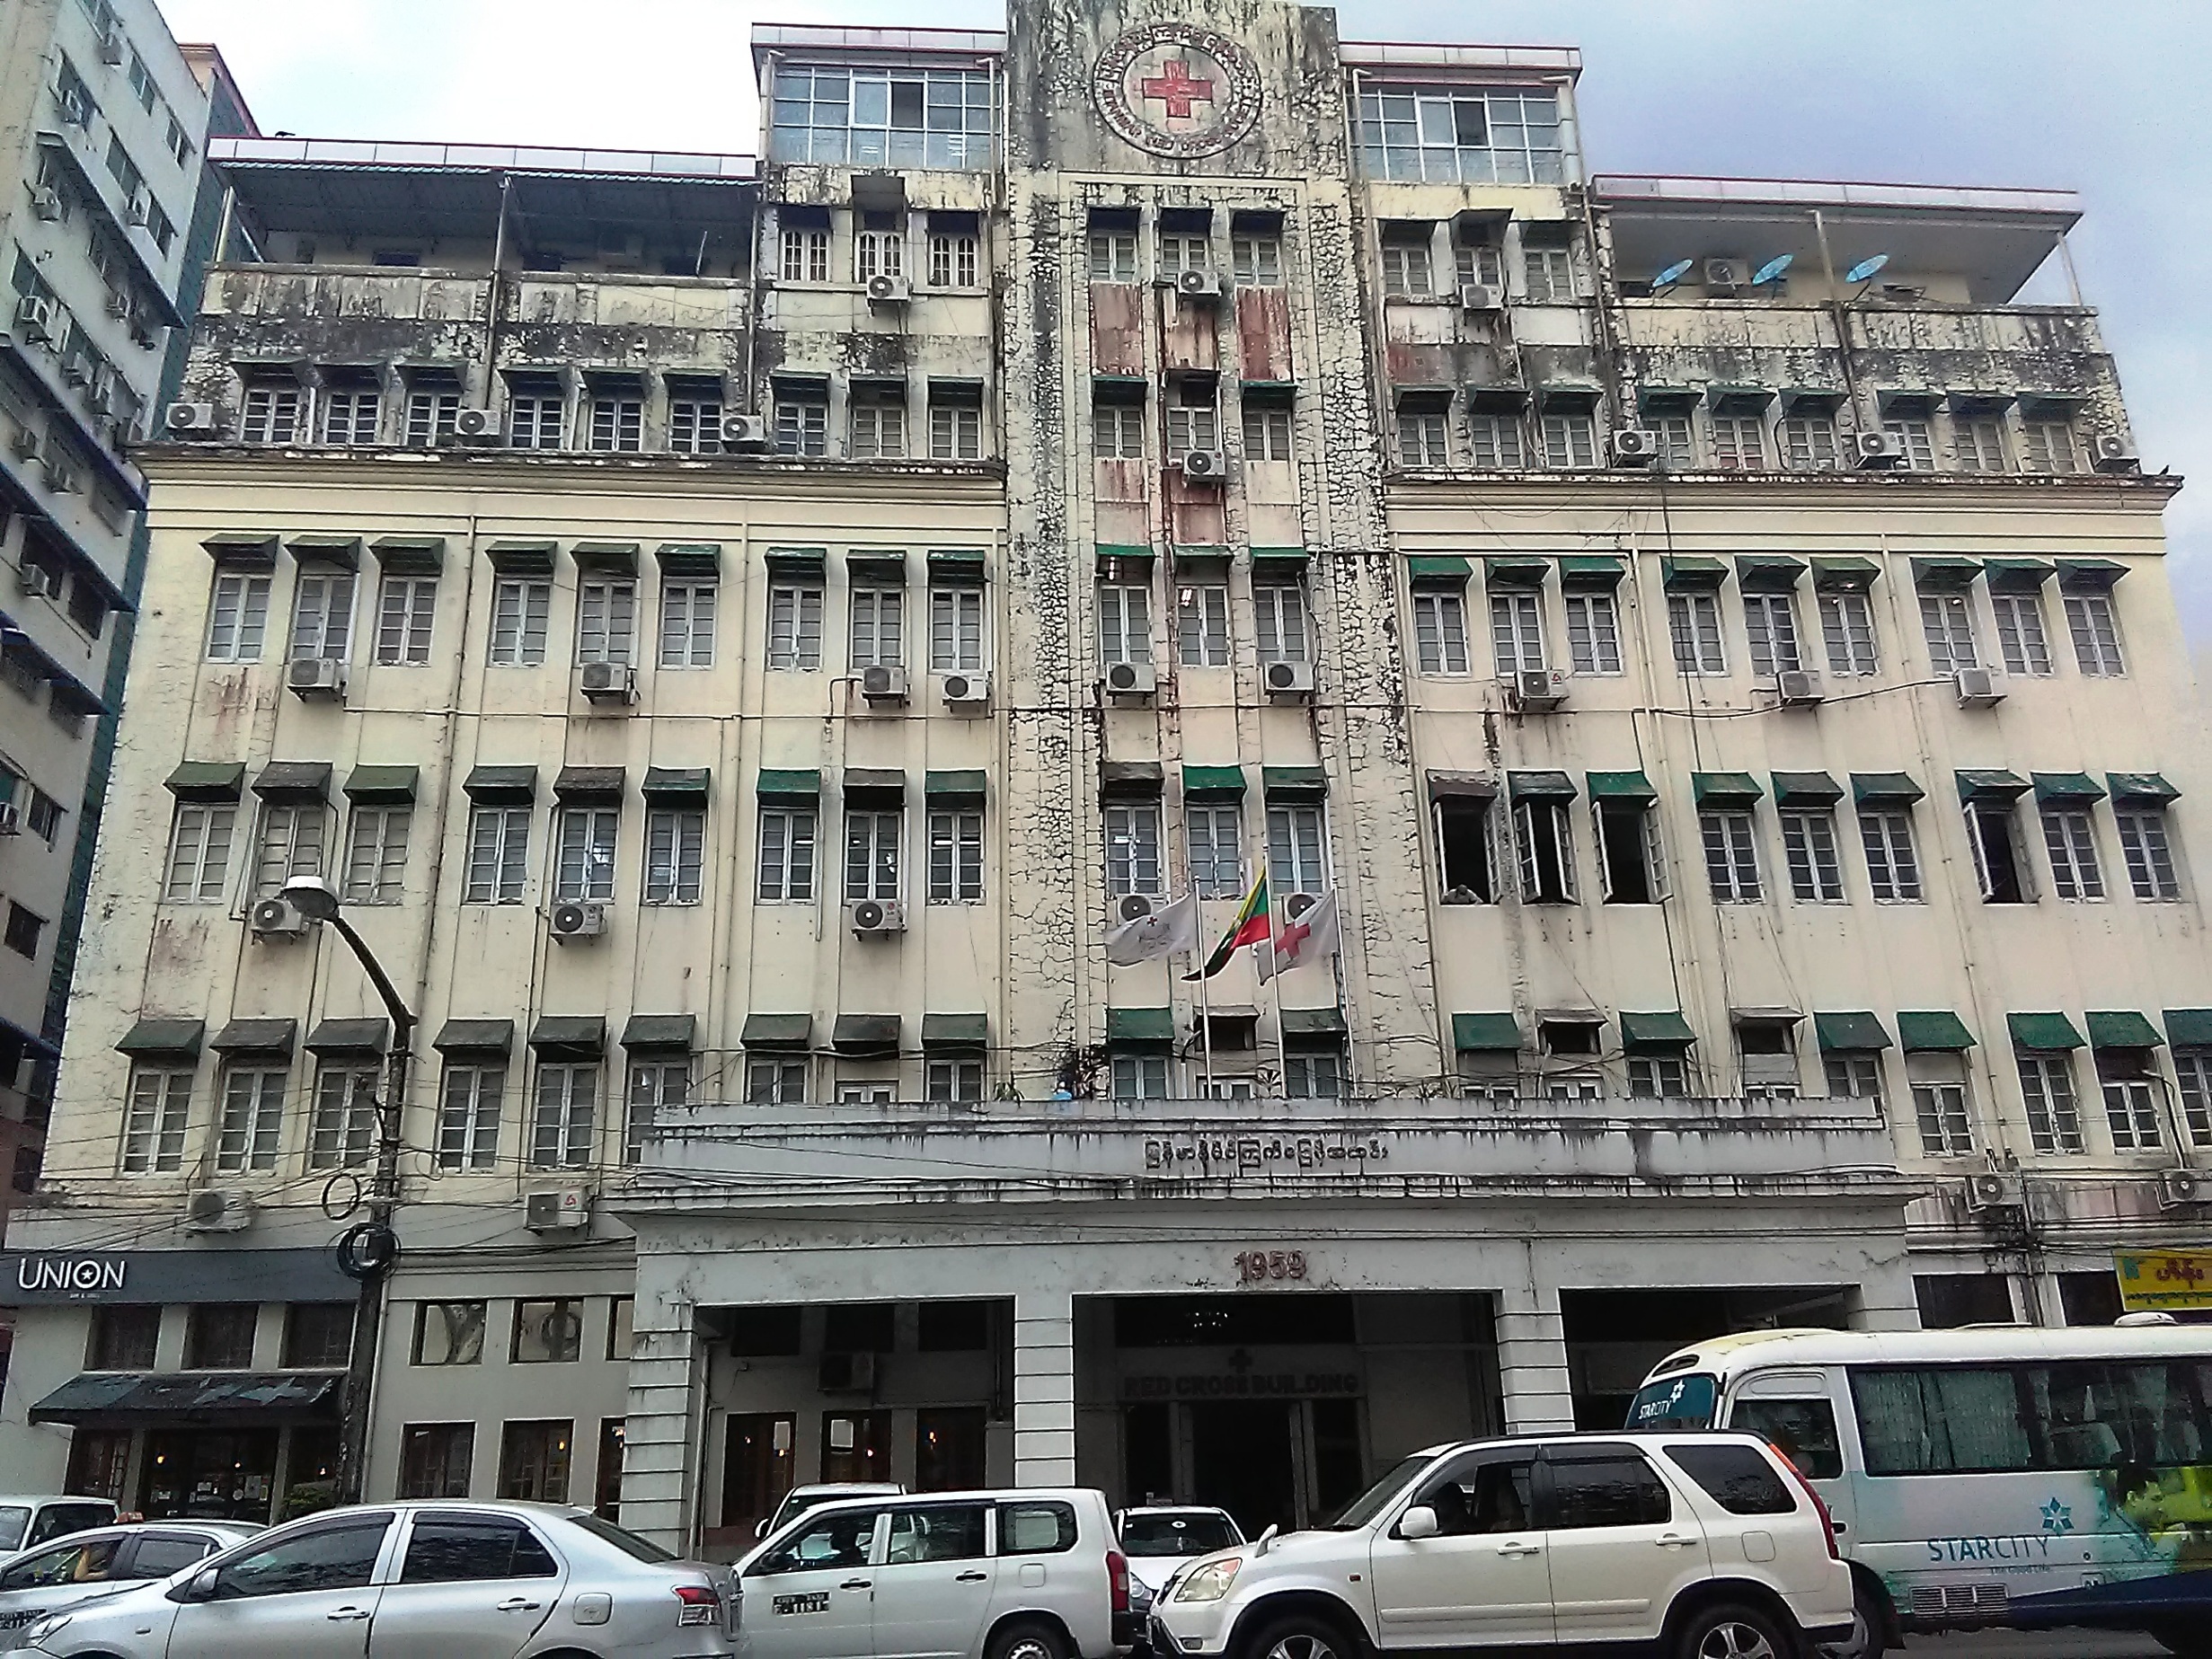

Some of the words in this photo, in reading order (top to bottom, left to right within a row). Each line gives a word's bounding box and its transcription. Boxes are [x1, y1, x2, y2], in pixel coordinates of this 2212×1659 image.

[18, 1257, 126, 1290] UNION
[1234, 1249, 1307, 1281] 1959
[1123, 1375, 1172, 1398] RED
[1927, 1534, 2049, 1562] STARCITY
